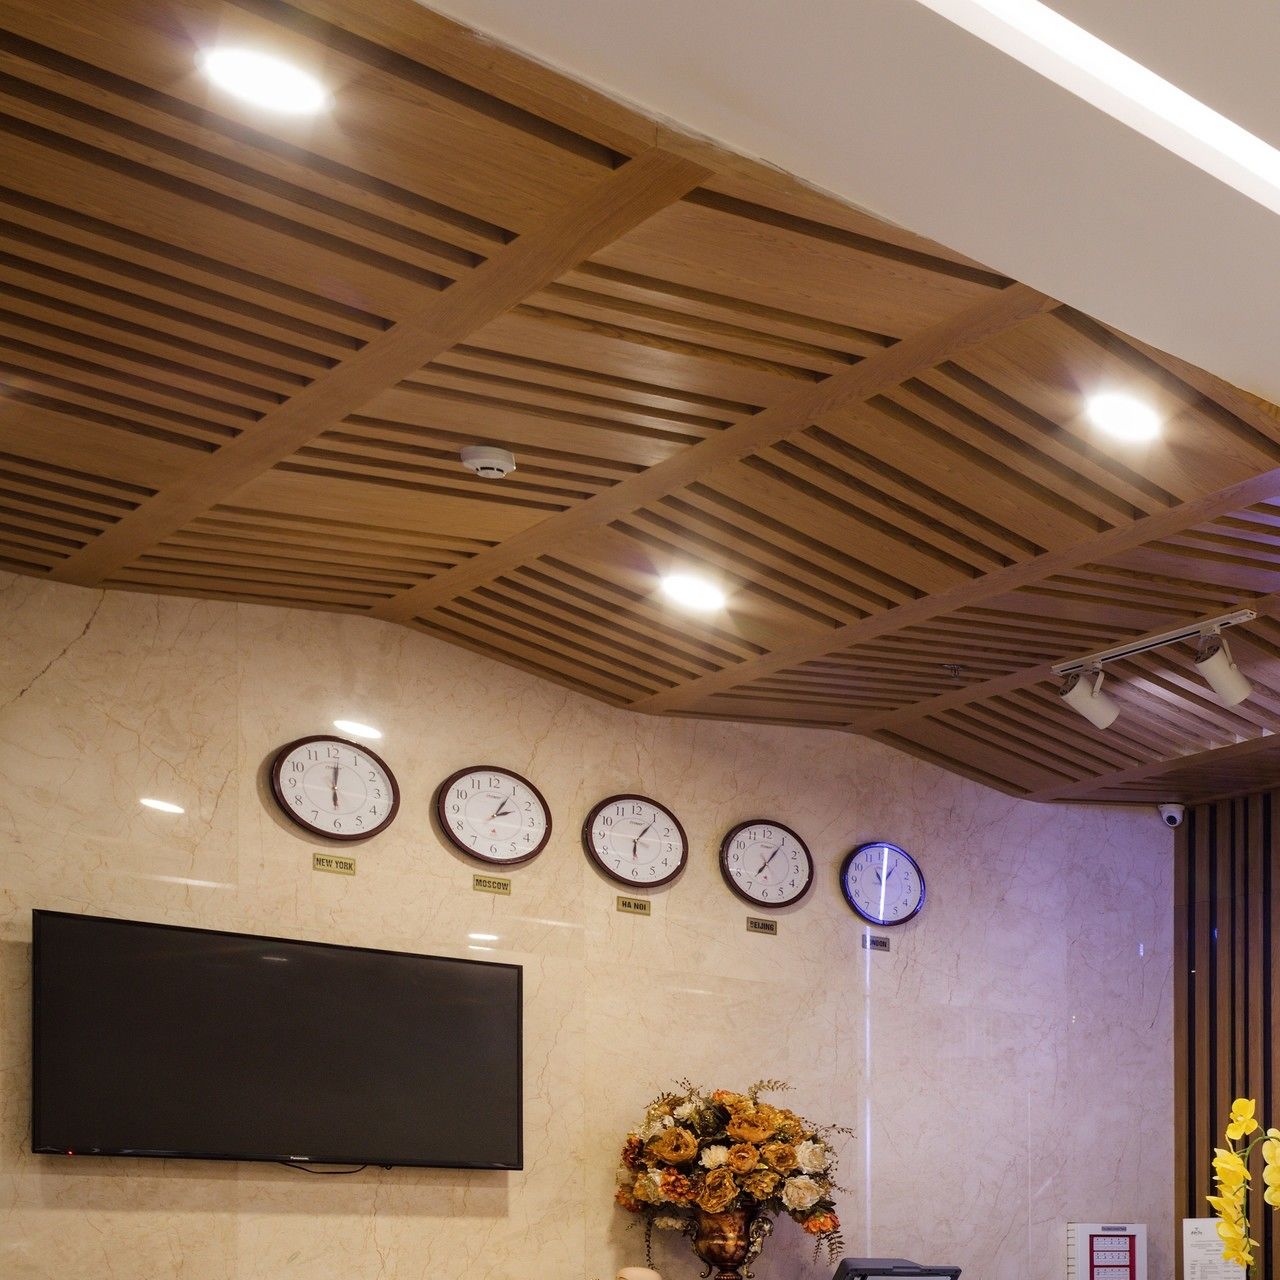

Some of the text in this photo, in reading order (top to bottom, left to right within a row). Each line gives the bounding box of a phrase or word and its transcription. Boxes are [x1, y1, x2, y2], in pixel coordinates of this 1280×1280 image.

[308, 749, 318, 761] 11
[327, 747, 340, 758] 12
[291, 761, 304, 773] 10
[368, 771, 376, 782] 2
[288, 777, 297, 788] 9
[471, 779, 481, 789] 11
[488, 778, 500, 788] 12
[374, 788, 381, 799] 3
[456, 789, 468, 800] 10
[294, 795, 303, 806] 8
[369, 805, 377, 815] 4
[452, 804, 460, 814] 9
[524, 801, 532, 811] 2
[616, 806, 625, 816] 11
[632, 805, 642, 815] 12
[311, 810, 319, 820] 7
[333, 818, 342, 829] 6
[355, 816, 363, 827] 5
[456, 820, 464, 831] 8
[528, 817, 535, 827] 3
[602, 816, 613, 826] 10
[523, 833, 530, 842] 4
[599, 830, 605, 839] 9
[663, 828, 670, 837] 2
[748, 831, 757, 840] 11
[762, 830, 773, 839] 12
[470, 835, 477, 845] 7
[736, 840, 746, 850] 10
[490, 844, 497, 854] 6
[509, 842, 517, 852] 5
[602, 846, 609, 856] 8
[666, 843, 673, 852] 3
[732, 854, 739, 862] 9
[791, 851, 797, 860] 2
[865, 853, 873, 862] 11
[316, 858, 353, 871] NEW YORK
[614, 860, 621, 869] 7
[661, 858, 668, 867] 4
[854, 863, 863, 871] 10
[631, 868, 639, 877] 6
[649, 866, 656, 876] 5
[793, 865, 799, 874] 3
[851, 875, 857, 884] 9
[904, 872, 910, 880] 2
[475, 879, 509, 891] MOSCOW
[746, 881, 753, 890] 7
[789, 879, 795, 888] 4
[762, 889, 768, 898] 6
[778, 887, 784, 896] 5
[854, 889, 860, 898] 8
[906, 885, 912, 894] 3
[621, 901, 647, 911] HA NOI
[864, 901, 870, 910] 7
[893, 906, 898, 915] 5
[750, 921, 774, 932] BEIJING
